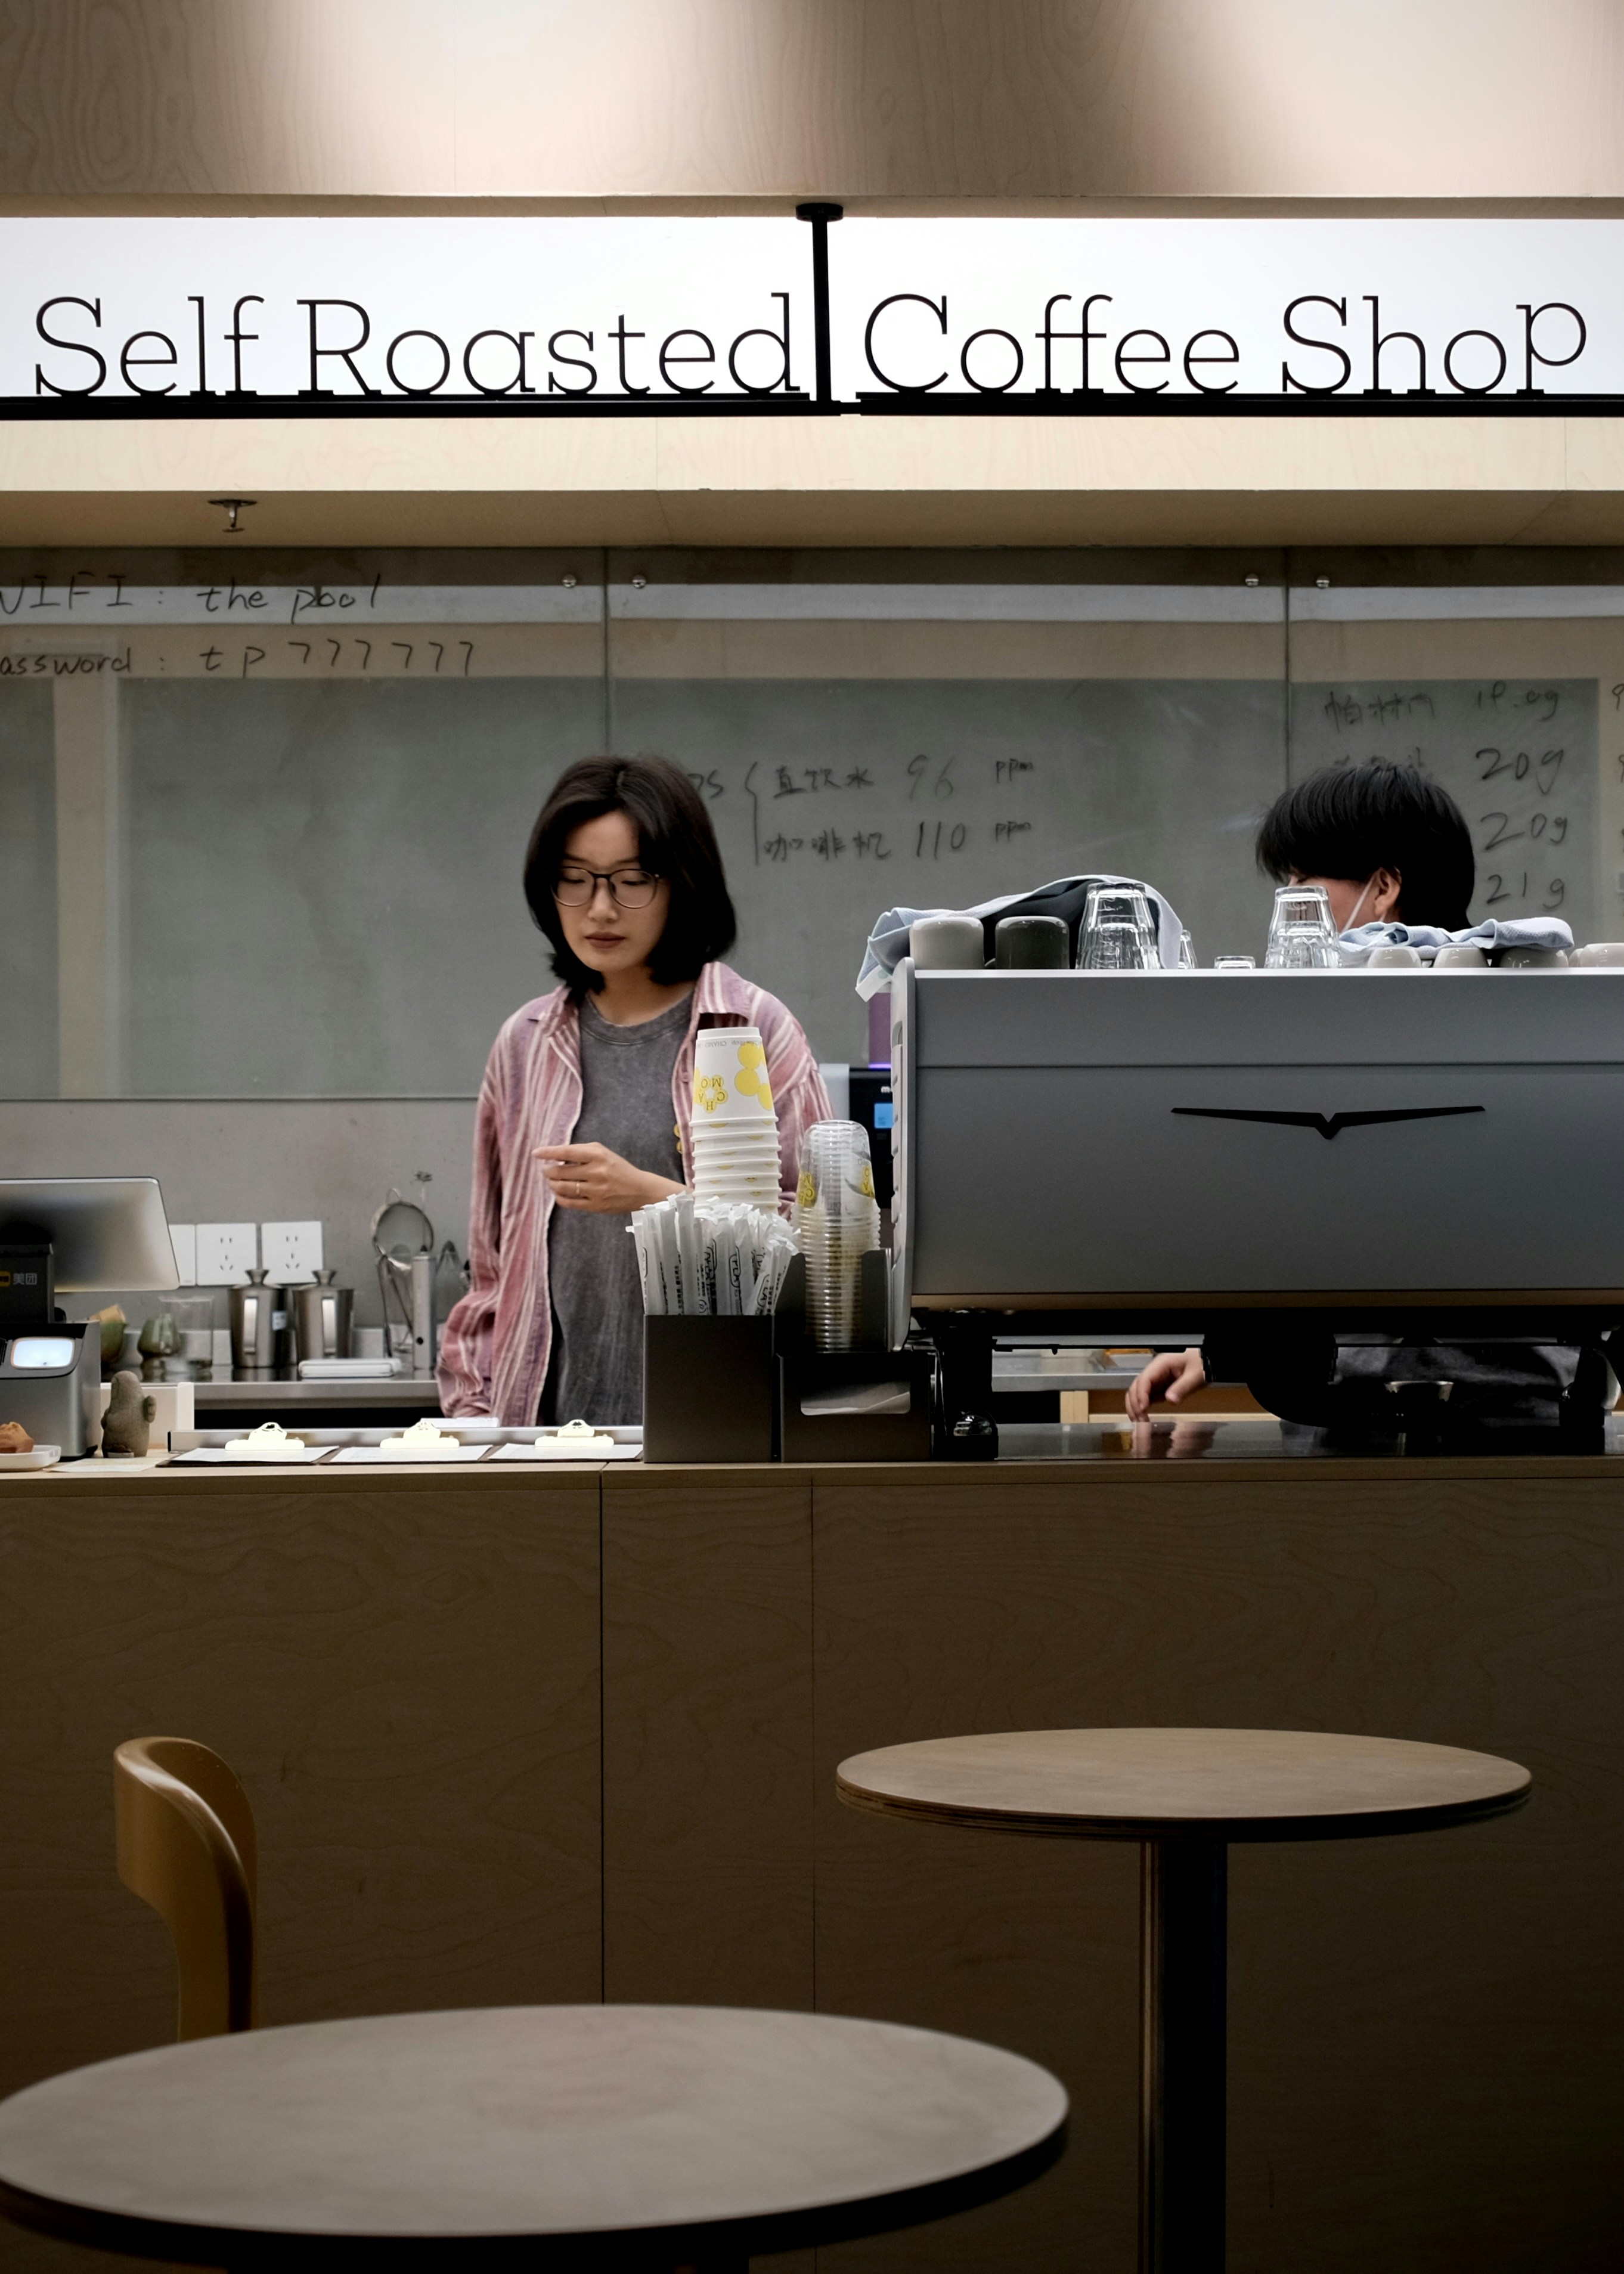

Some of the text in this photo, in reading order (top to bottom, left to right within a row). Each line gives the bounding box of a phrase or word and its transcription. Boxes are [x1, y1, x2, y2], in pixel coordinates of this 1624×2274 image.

[35, 292, 1587, 395] Self Roasted Coffee Shop
[196, 580, 269, 613] the
[290, 574, 382, 624] pool
[1474, 747, 1565, 797] 20g
[764, 827, 891, 863] 咖啡机
[915, 821, 967, 860] 110
[1480, 812, 1569, 854] 20g
[13, 1272, 37, 1285] 美团
